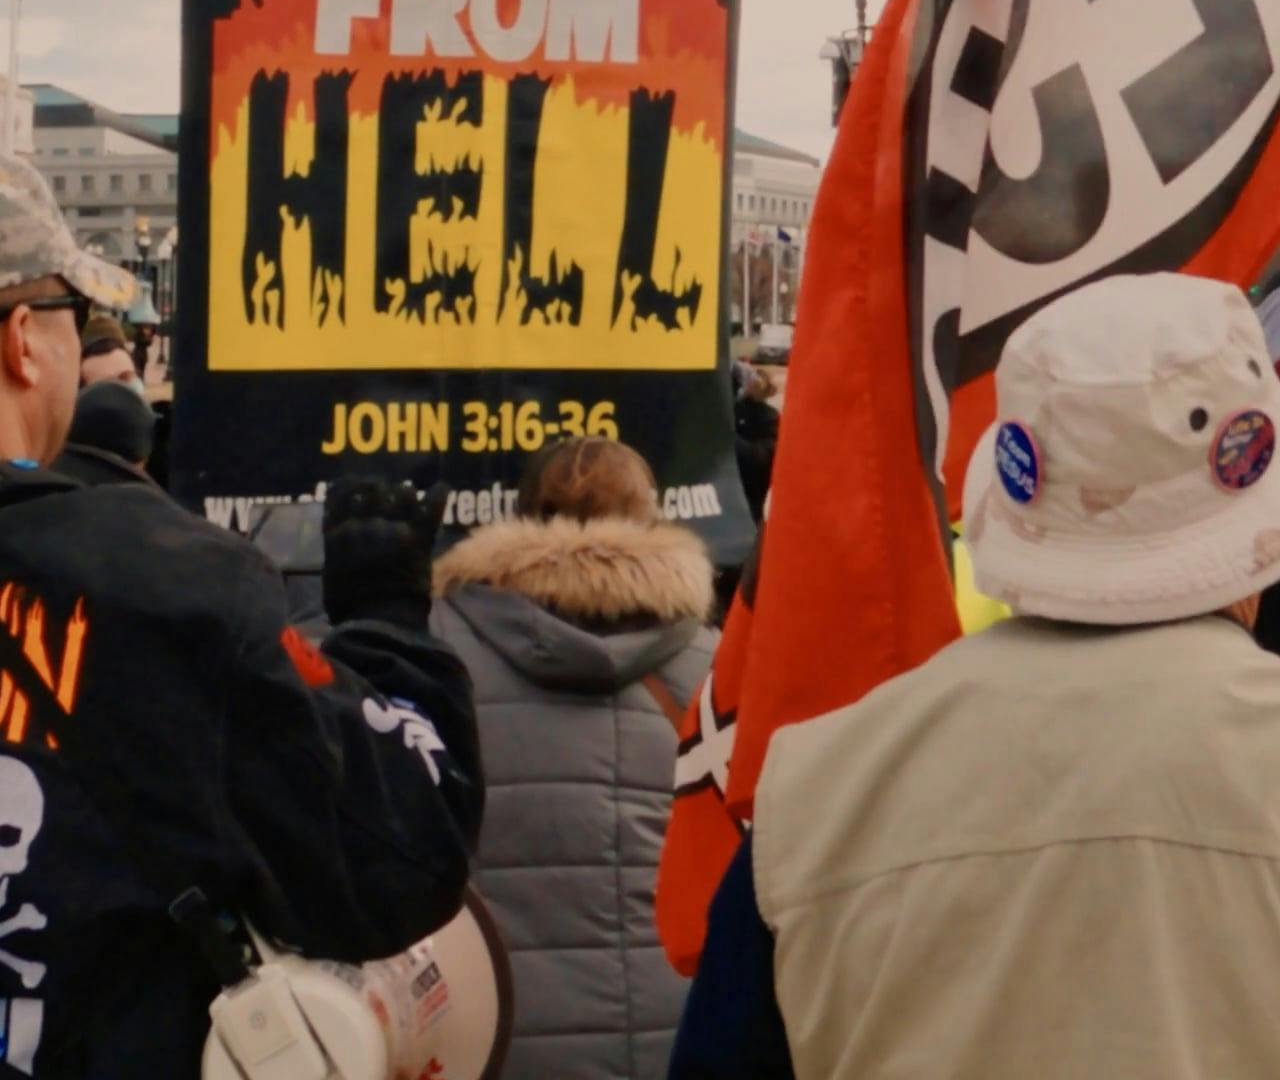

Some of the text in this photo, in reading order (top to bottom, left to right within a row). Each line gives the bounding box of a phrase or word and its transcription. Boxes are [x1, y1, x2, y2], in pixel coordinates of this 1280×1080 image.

[242, 68, 702, 332] HELL
[322, 401, 619, 454] JOHN 3:16-36
